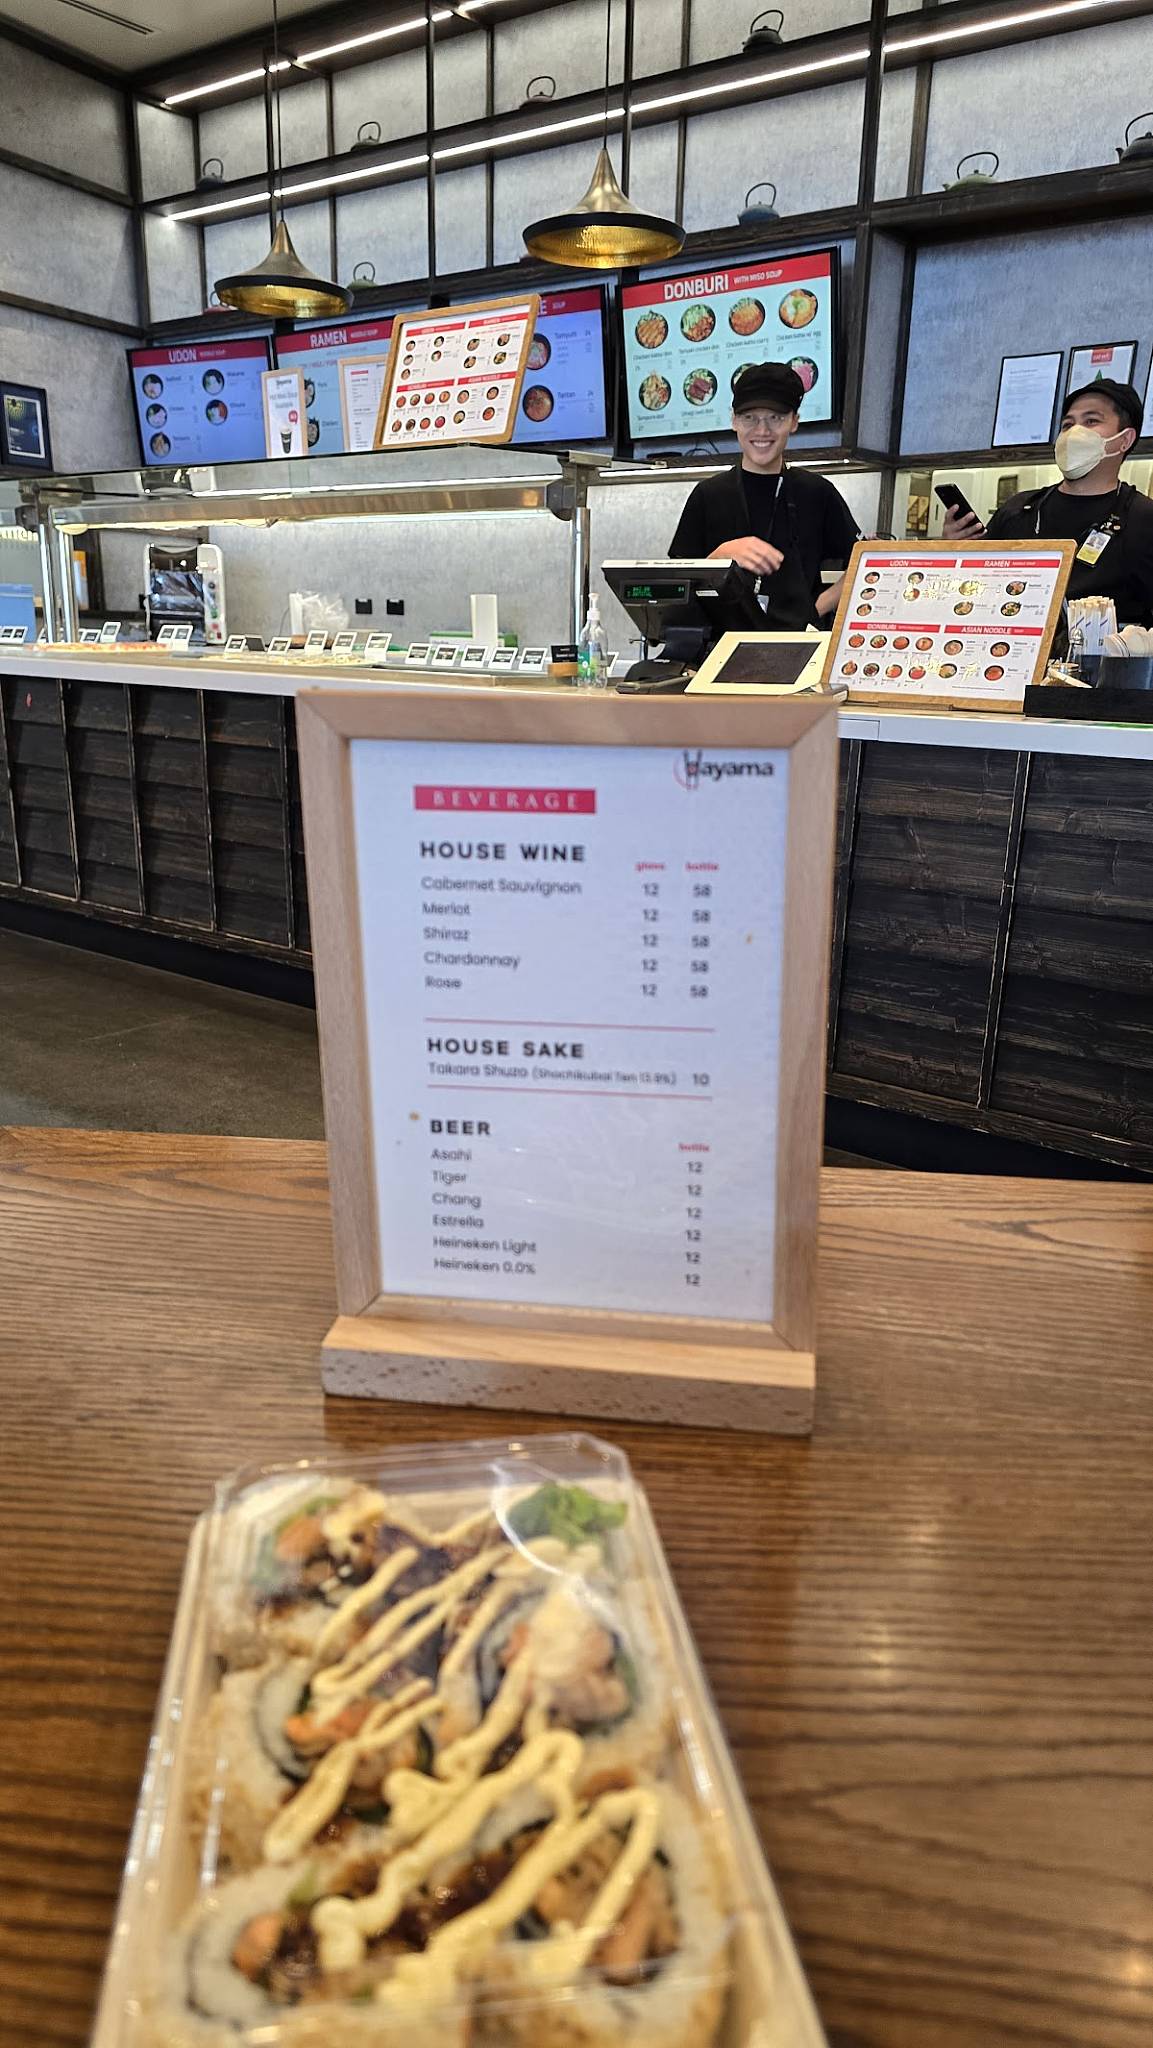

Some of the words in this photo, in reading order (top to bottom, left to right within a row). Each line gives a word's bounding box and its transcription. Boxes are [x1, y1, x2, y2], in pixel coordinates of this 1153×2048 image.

[664, 274, 728, 300] DONBURI
[733, 276, 750, 285] WITH
[750, 272, 765, 282] MISO
[766, 269, 783, 280] SOUP
[310, 329, 348, 348] RAMEN
[168, 348, 197, 363] UDON
[433, 790, 578, 809] BEVERAGE
[420, 841, 506, 860] HOUSE
[520, 843, 585, 862] WINE
[685, 862, 720, 872] bottle
[421, 876, 494, 892] Cabernet
[498, 878, 583, 898] Sauvignon
[643, 882, 659, 897] 12
[693, 883, 712, 897] 58
[422, 902, 470, 916] Merlot
[643, 909, 659, 922] 12
[692, 909, 711, 923] 58
[423, 926, 469, 941] Shiraz
[642, 934, 659, 947] 12
[691, 935, 710, 948] 58
[423, 950, 520, 971] Chardonnay
[642, 958, 658, 972] 12
[691, 960, 709, 974] 58
[425, 975, 462, 989] Rose
[641, 984, 657, 997] 12
[690, 985, 709, 998] 58
[428, 1038, 509, 1055] HOUSE
[523, 1041, 585, 1058] SAKE
[429, 1061, 480, 1076] Takara
[483, 1064, 529, 1077] Shuzo
[692, 1072, 710, 1086] 10
[430, 1119, 491, 1135] BEER
[431, 1148, 472, 1161] Asahi
[688, 1161, 703, 1174] 12
[432, 1170, 467, 1185] Tiger
[687, 1184, 702, 1197] 12
[432, 1192, 481, 1209] Chang
[432, 1214, 484, 1228] Estrella
[686, 1207, 702, 1219] 12
[686, 1229, 701, 1242] 12
[433, 1236, 500, 1251] Heineken
[502, 1239, 537, 1255] Light
[685, 1251, 701, 1264] 12
[434, 1258, 500, 1272] Heineken
[502, 1261, 536, 1275] 0.0%
[685, 1273, 701, 1286] 12
